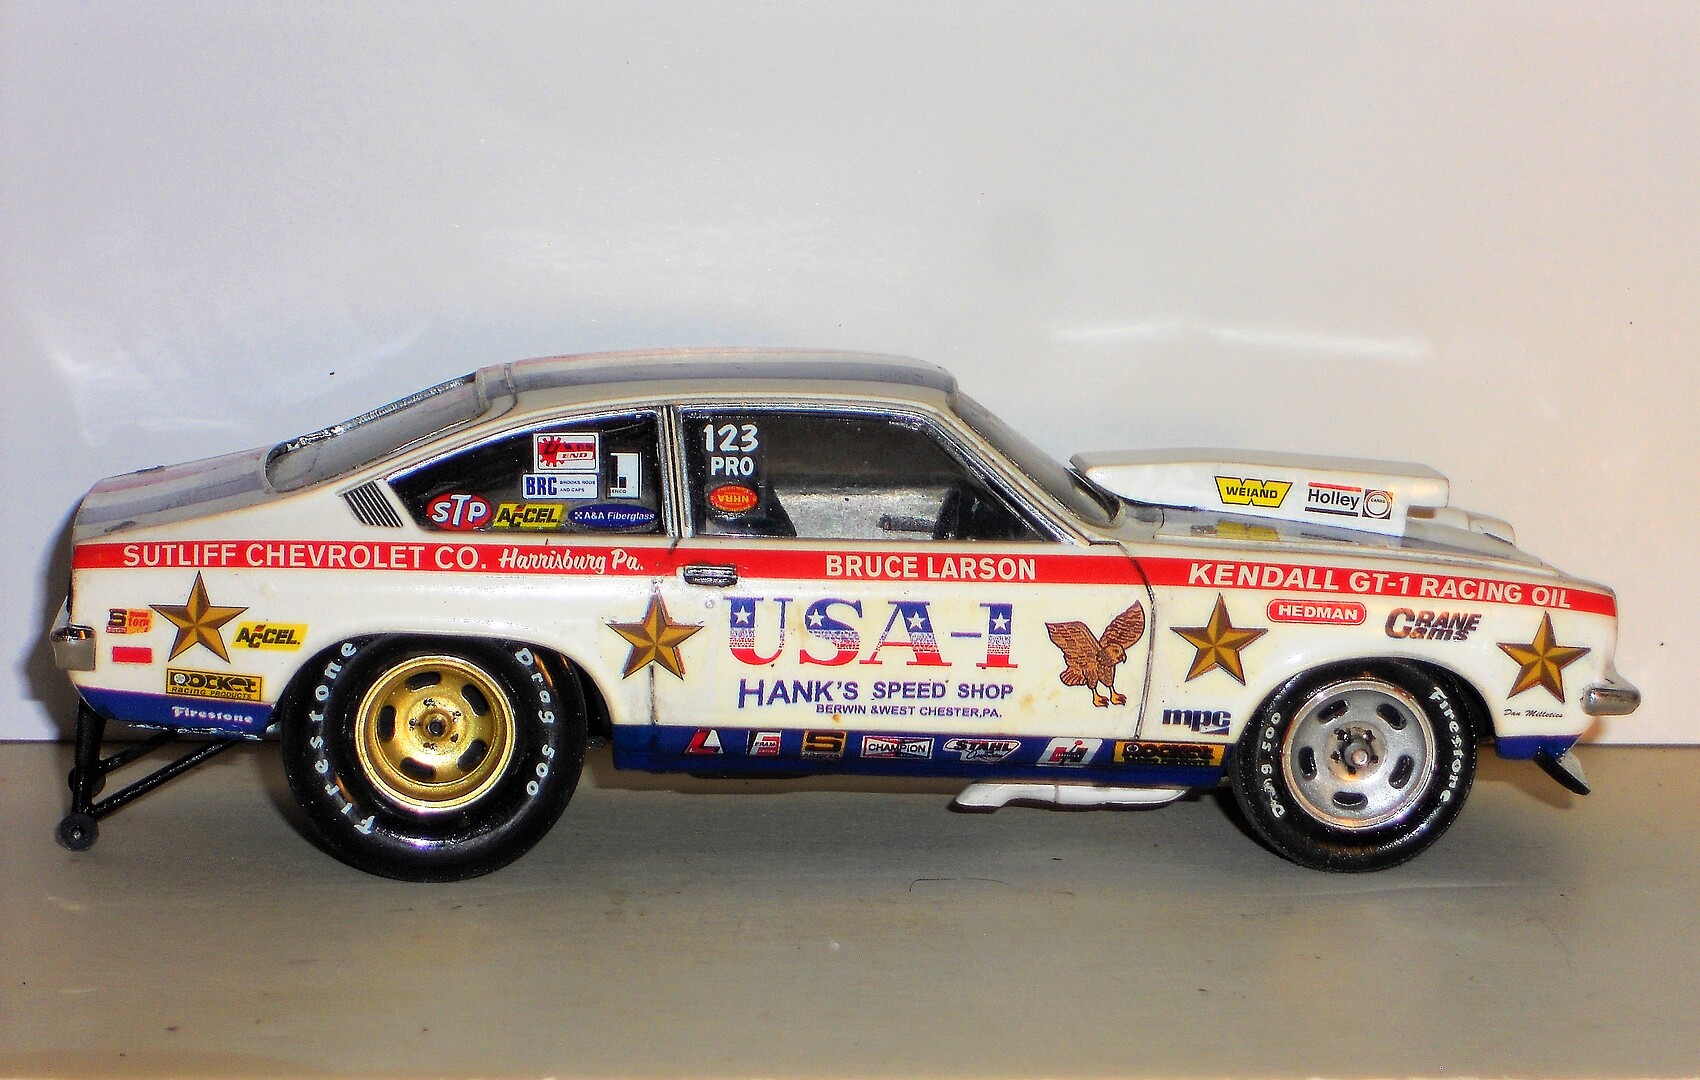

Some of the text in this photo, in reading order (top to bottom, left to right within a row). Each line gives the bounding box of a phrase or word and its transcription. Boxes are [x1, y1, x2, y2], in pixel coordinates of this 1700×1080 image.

[703, 424, 759, 452] 123
[710, 456, 754, 476] PRO
[526, 476, 557, 496] BRC
[1226, 486, 1278, 499] WEIAND
[1308, 488, 1361, 510] Holley
[432, 494, 487, 527] STP
[583, 511, 655, 522] A&A Fiberglass
[123, 543, 644, 575] SUTLIFF CHEVROLET CO. Harrisburg Pa.
[826, 555, 1036, 580] BRUCE LARSON
[1188, 563, 1571, 608] KENDALL GT-1 RACING OIL
[1278, 605, 1358, 621] HEDMAN
[1385, 608, 1482, 638] CRANE
[210, 690, 252, 699] PRODUCTS
[738, 678, 1013, 708] HANK'S SPEED SHOP
[171, 706, 253, 723] Firestone
[816, 703, 866, 715] BERWIN
[1162, 709, 1231, 731] mpc
[308, 642, 375, 835] Firestone
[868, 743, 927, 753] CHAMPION
[1429, 686, 1463, 803] Firestone
[526, 744, 556, 796] 500
